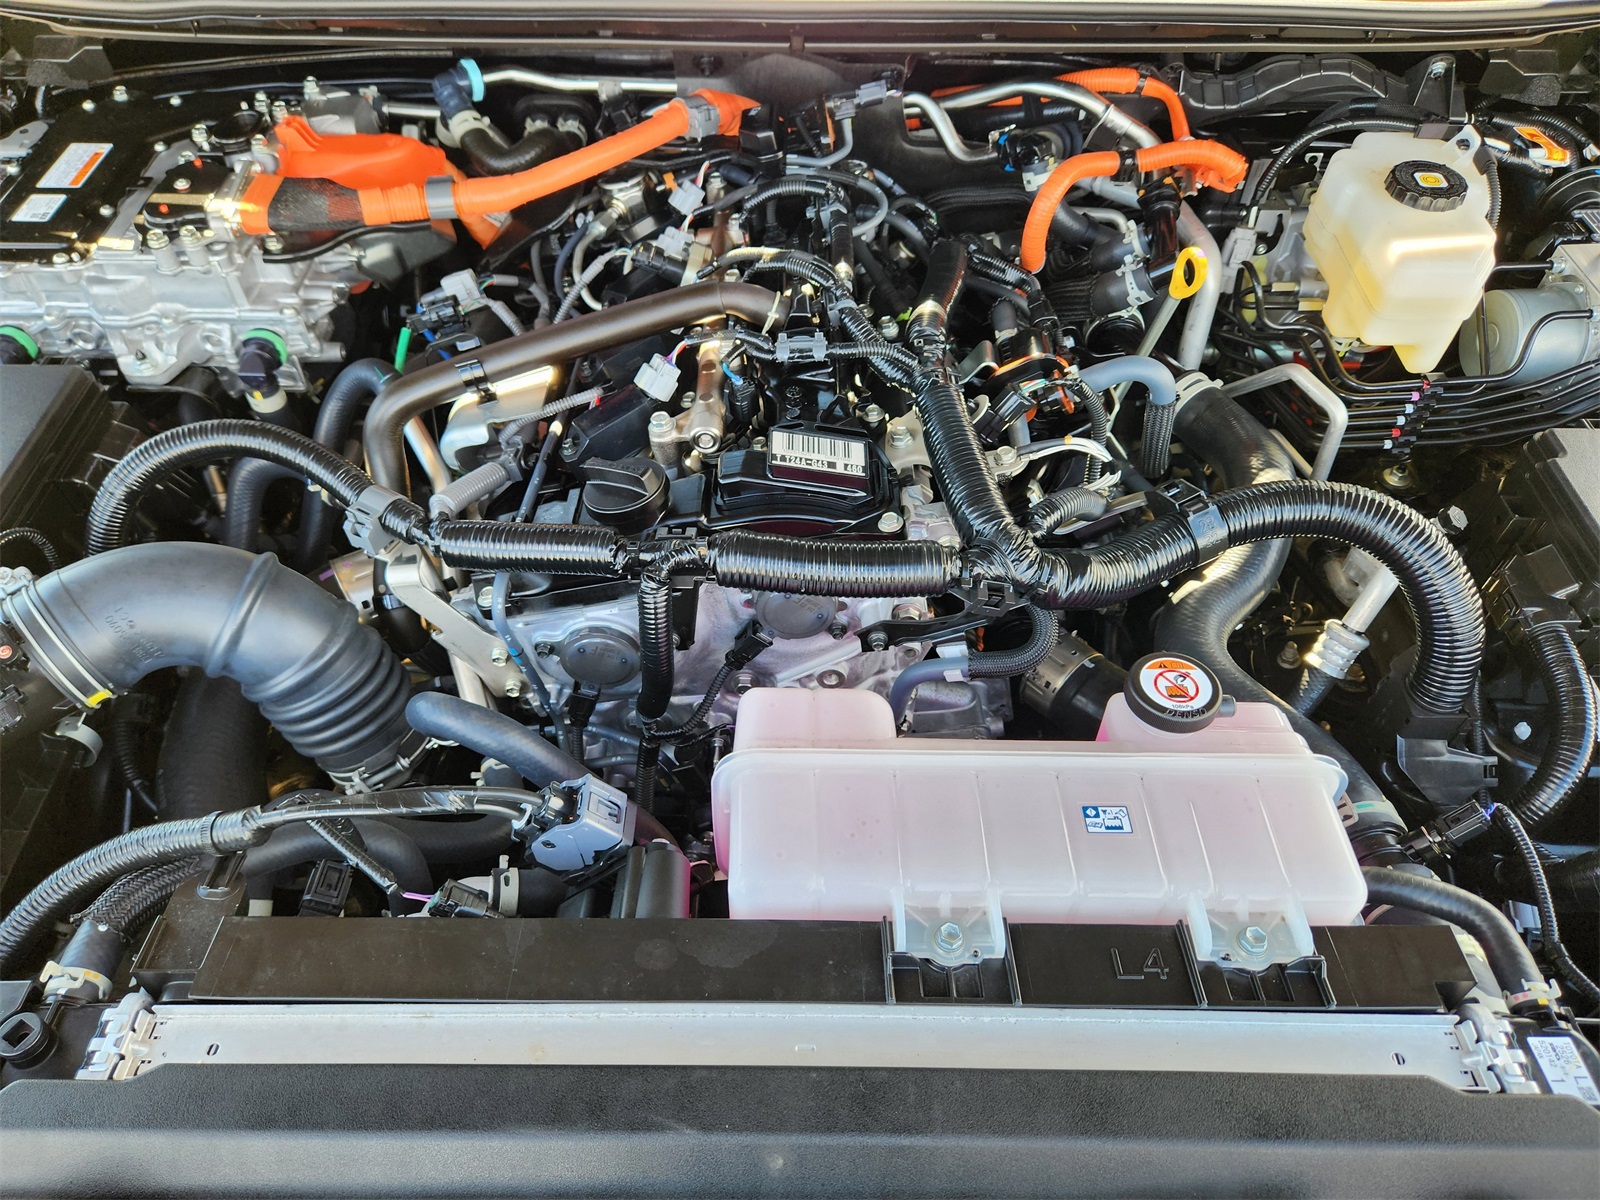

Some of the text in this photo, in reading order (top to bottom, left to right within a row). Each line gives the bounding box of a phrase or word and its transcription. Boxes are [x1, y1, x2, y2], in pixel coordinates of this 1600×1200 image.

[775, 454, 781, 463] T
[785, 456, 828, 469] T24A-G43
[846, 465, 863, 474] 460
[1164, 708, 1208, 719] DENSO
[1110, 947, 1170, 980] L4
[1563, 1042, 1582, 1069] TOYOTA
